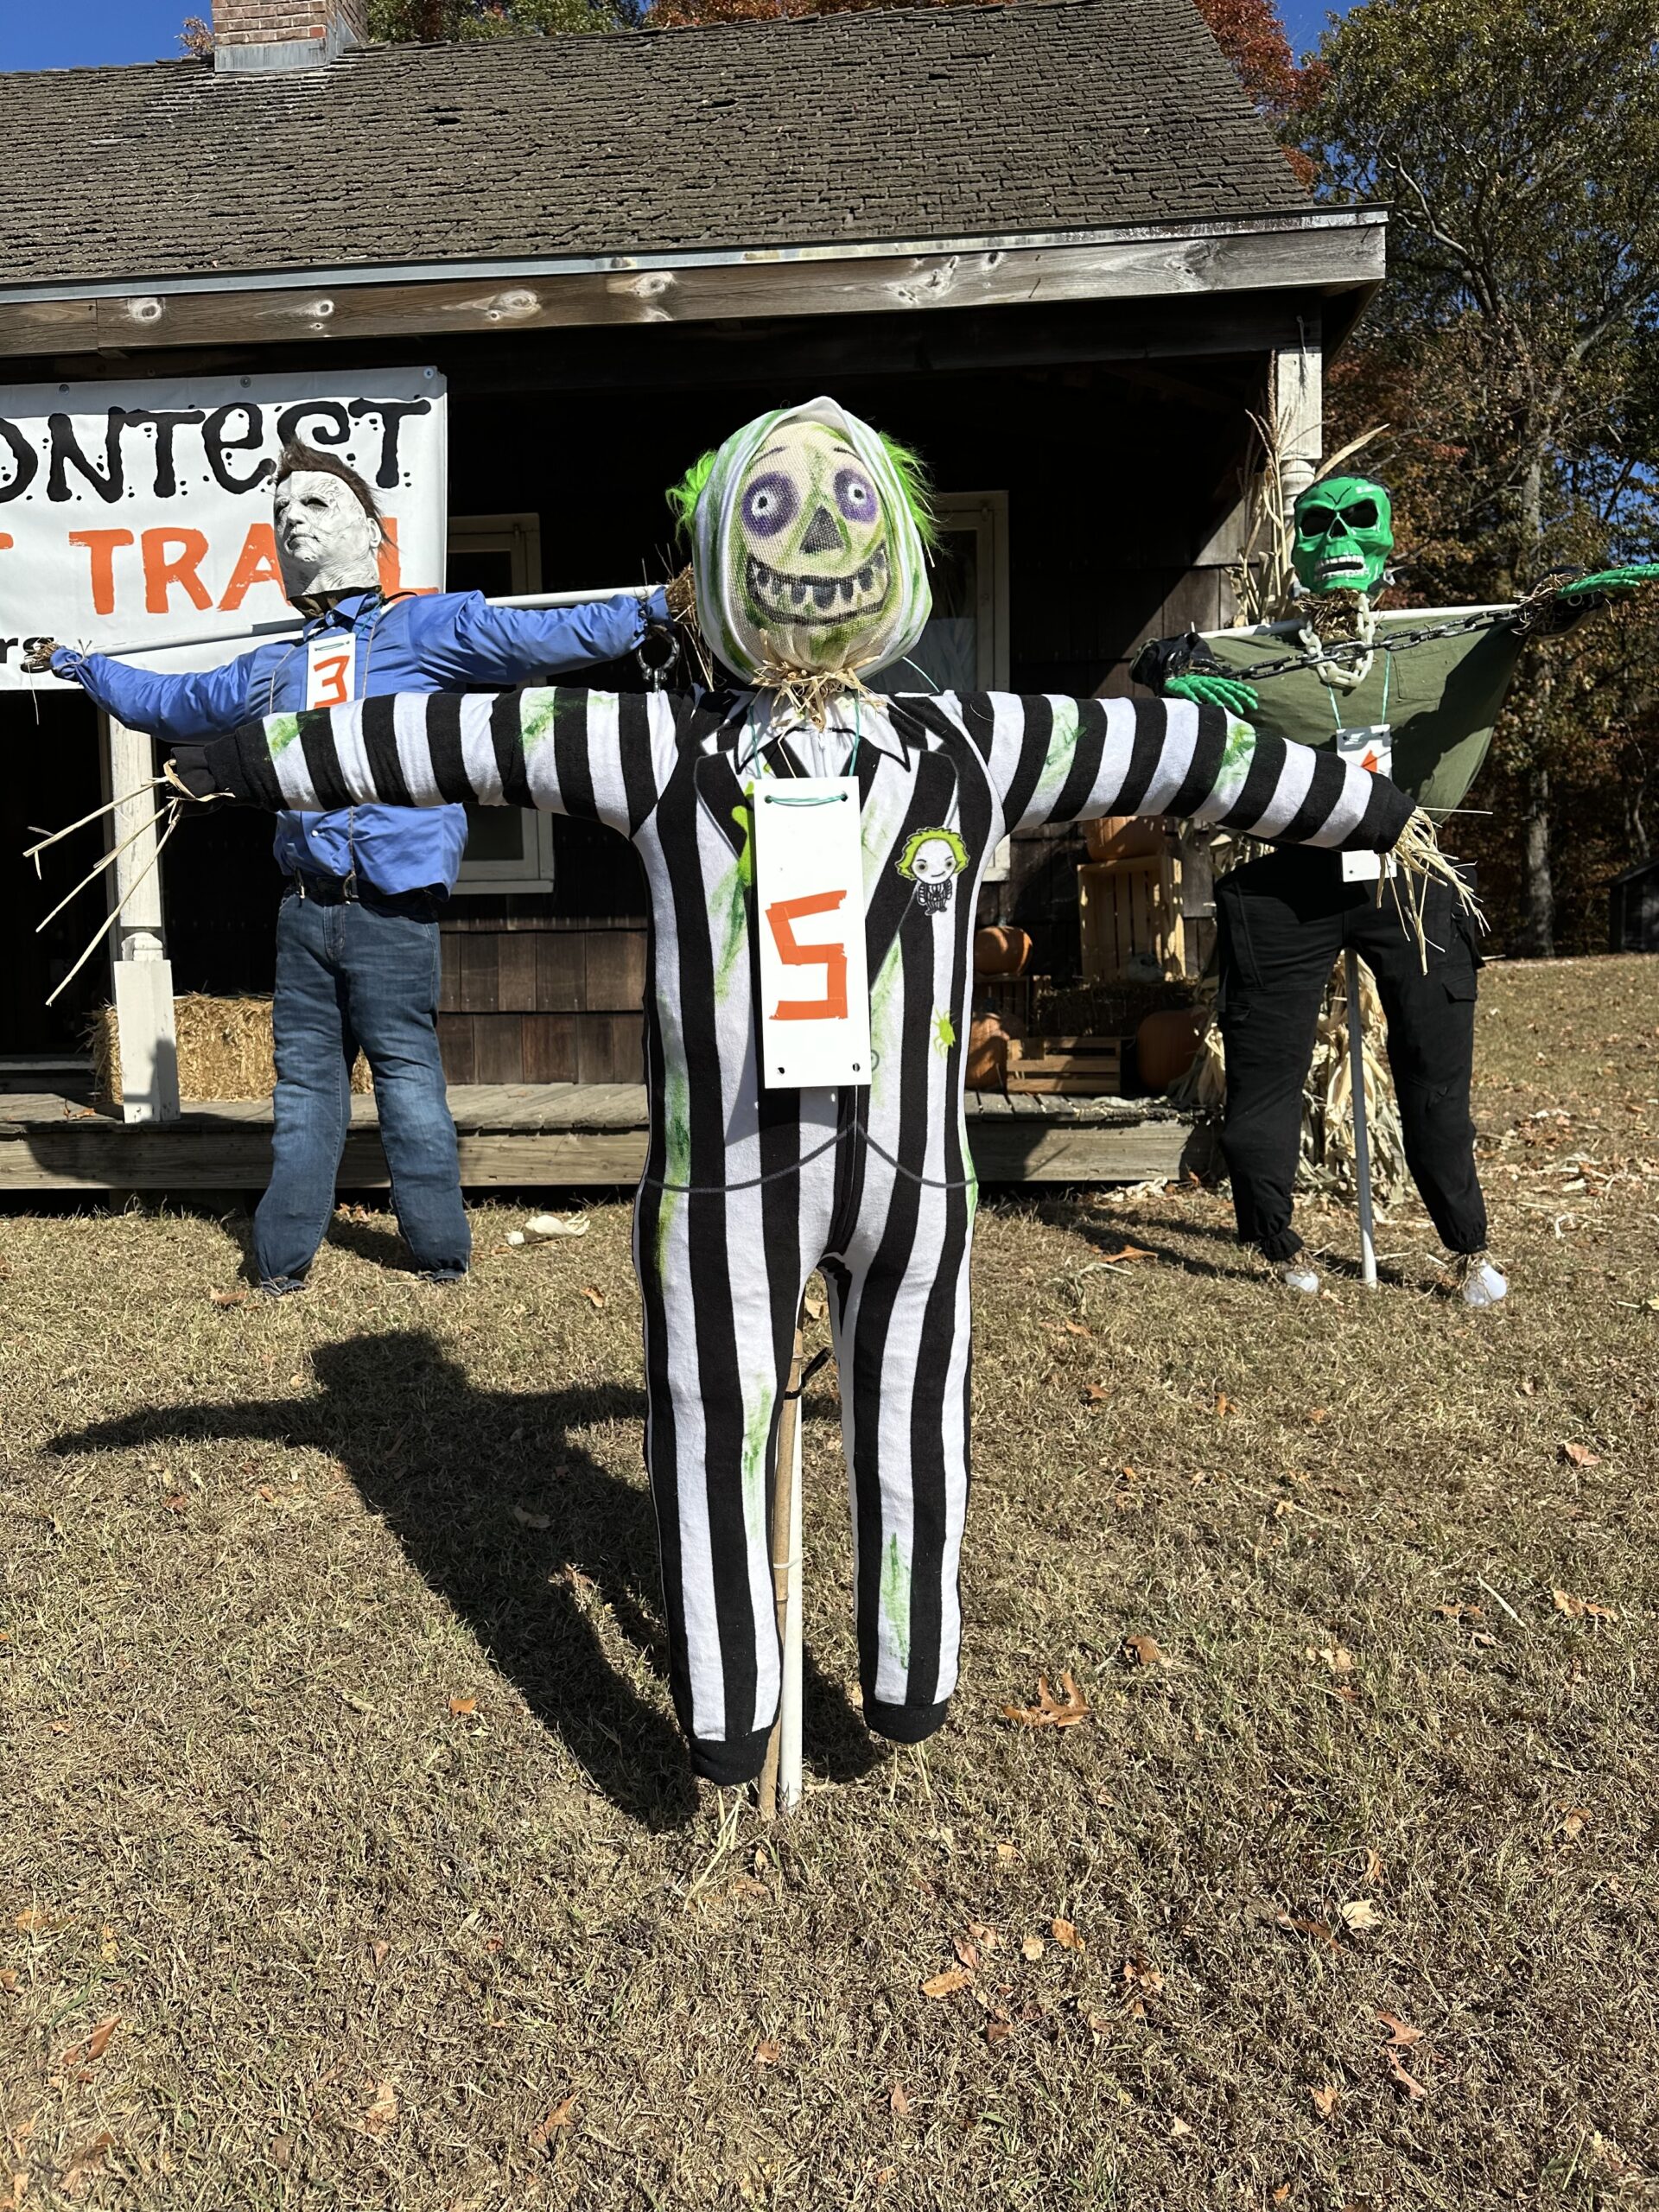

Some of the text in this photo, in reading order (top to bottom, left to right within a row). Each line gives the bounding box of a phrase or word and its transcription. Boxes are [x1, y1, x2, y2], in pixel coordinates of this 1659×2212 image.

[69, 516, 439, 614] TRAL
[314, 656, 350, 709] 3
[765, 890, 848, 1020] 5
